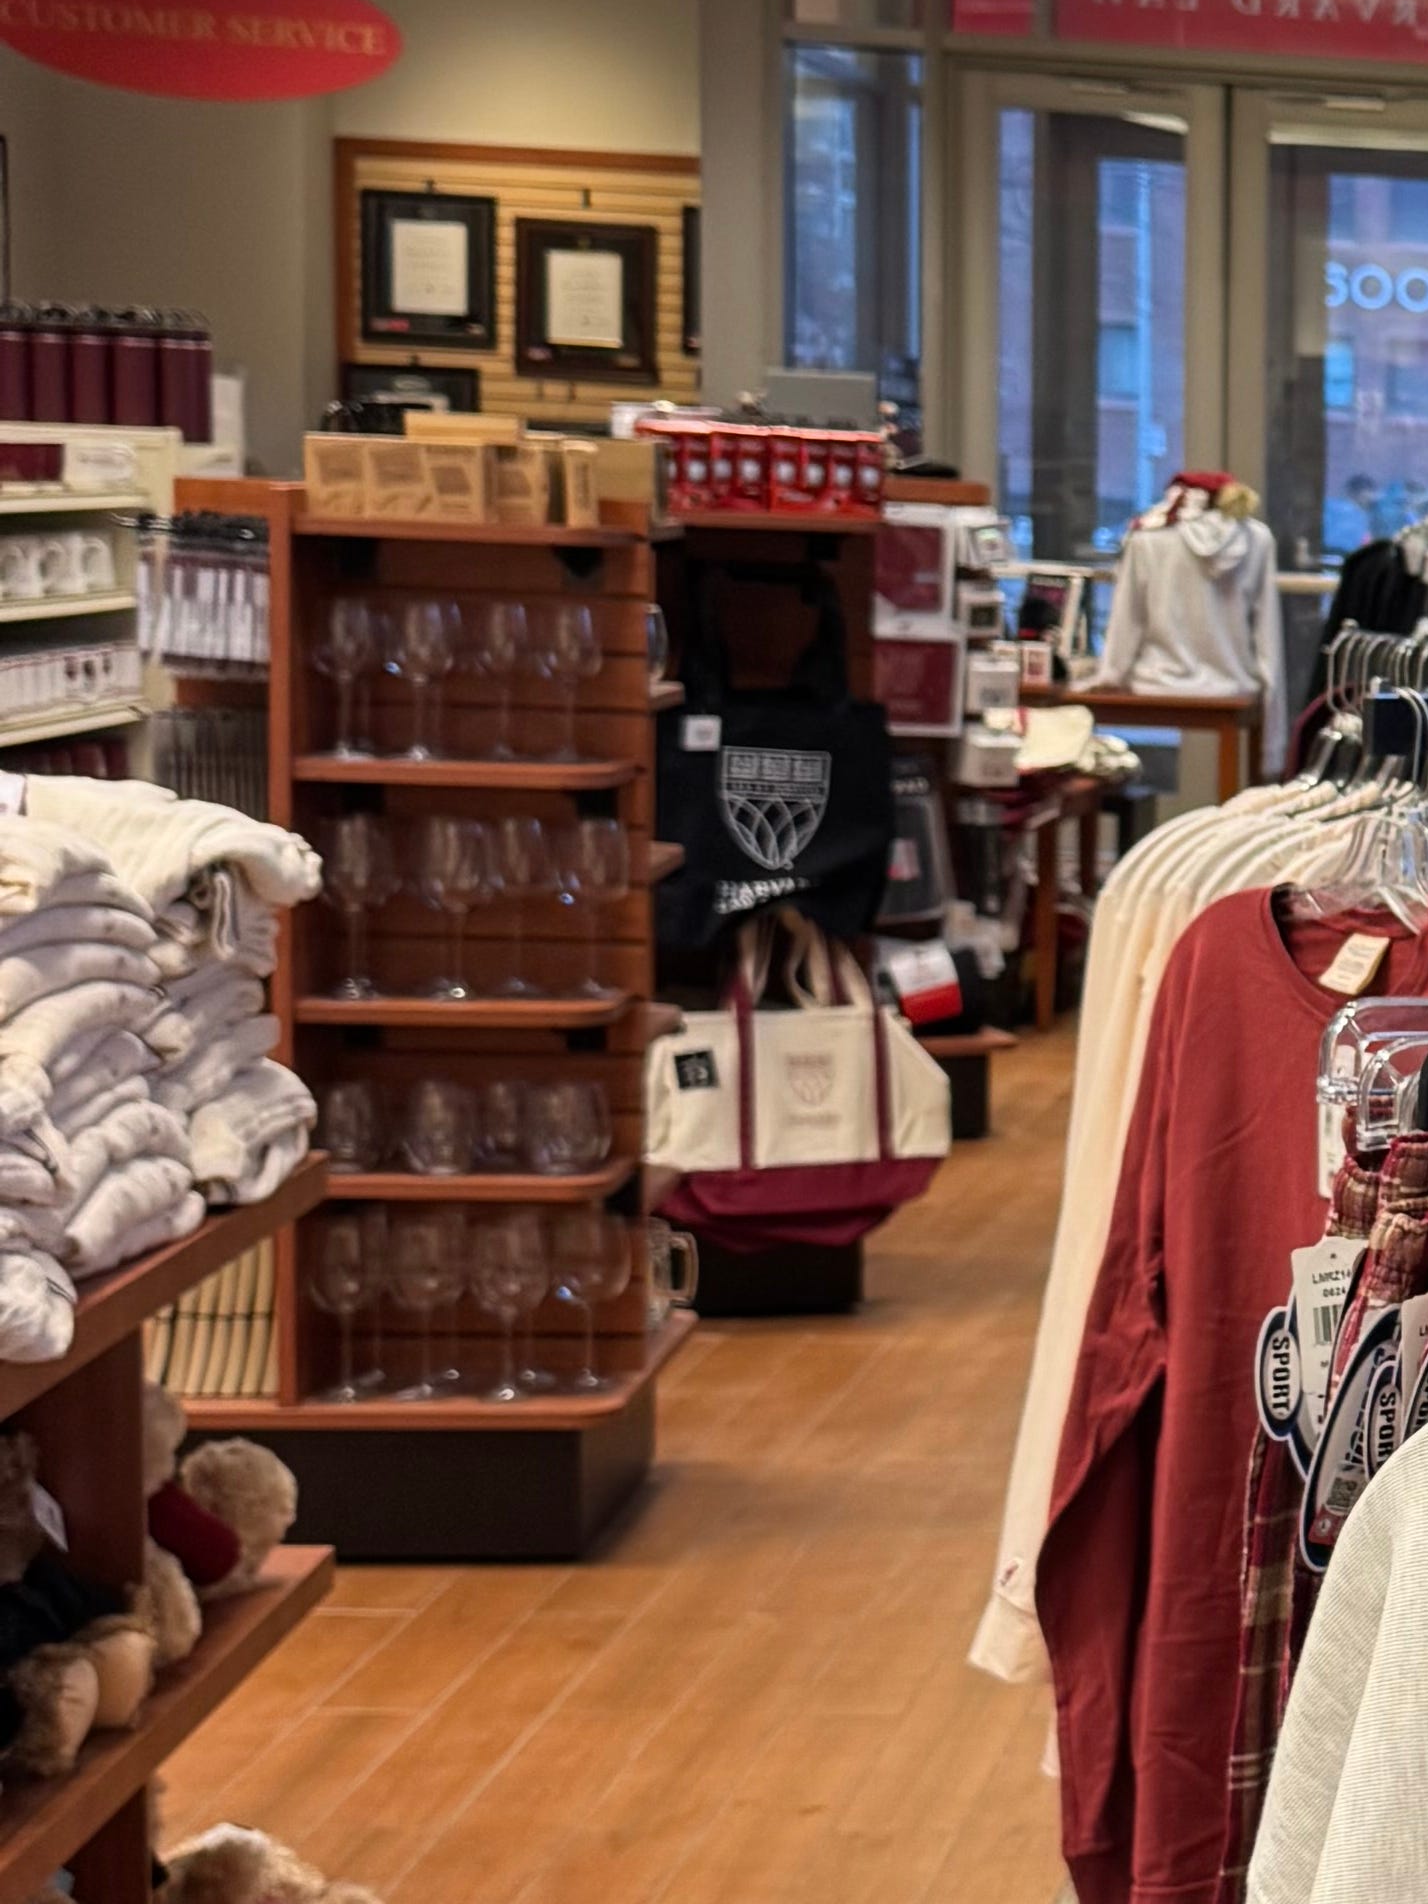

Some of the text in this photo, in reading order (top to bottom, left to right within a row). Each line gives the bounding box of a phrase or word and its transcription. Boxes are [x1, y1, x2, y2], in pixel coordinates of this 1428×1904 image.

[226, 15, 386, 56] SERVICE
[1272, 1336, 1290, 1412] SPORT
[1376, 1391, 1397, 1467] SPOR
